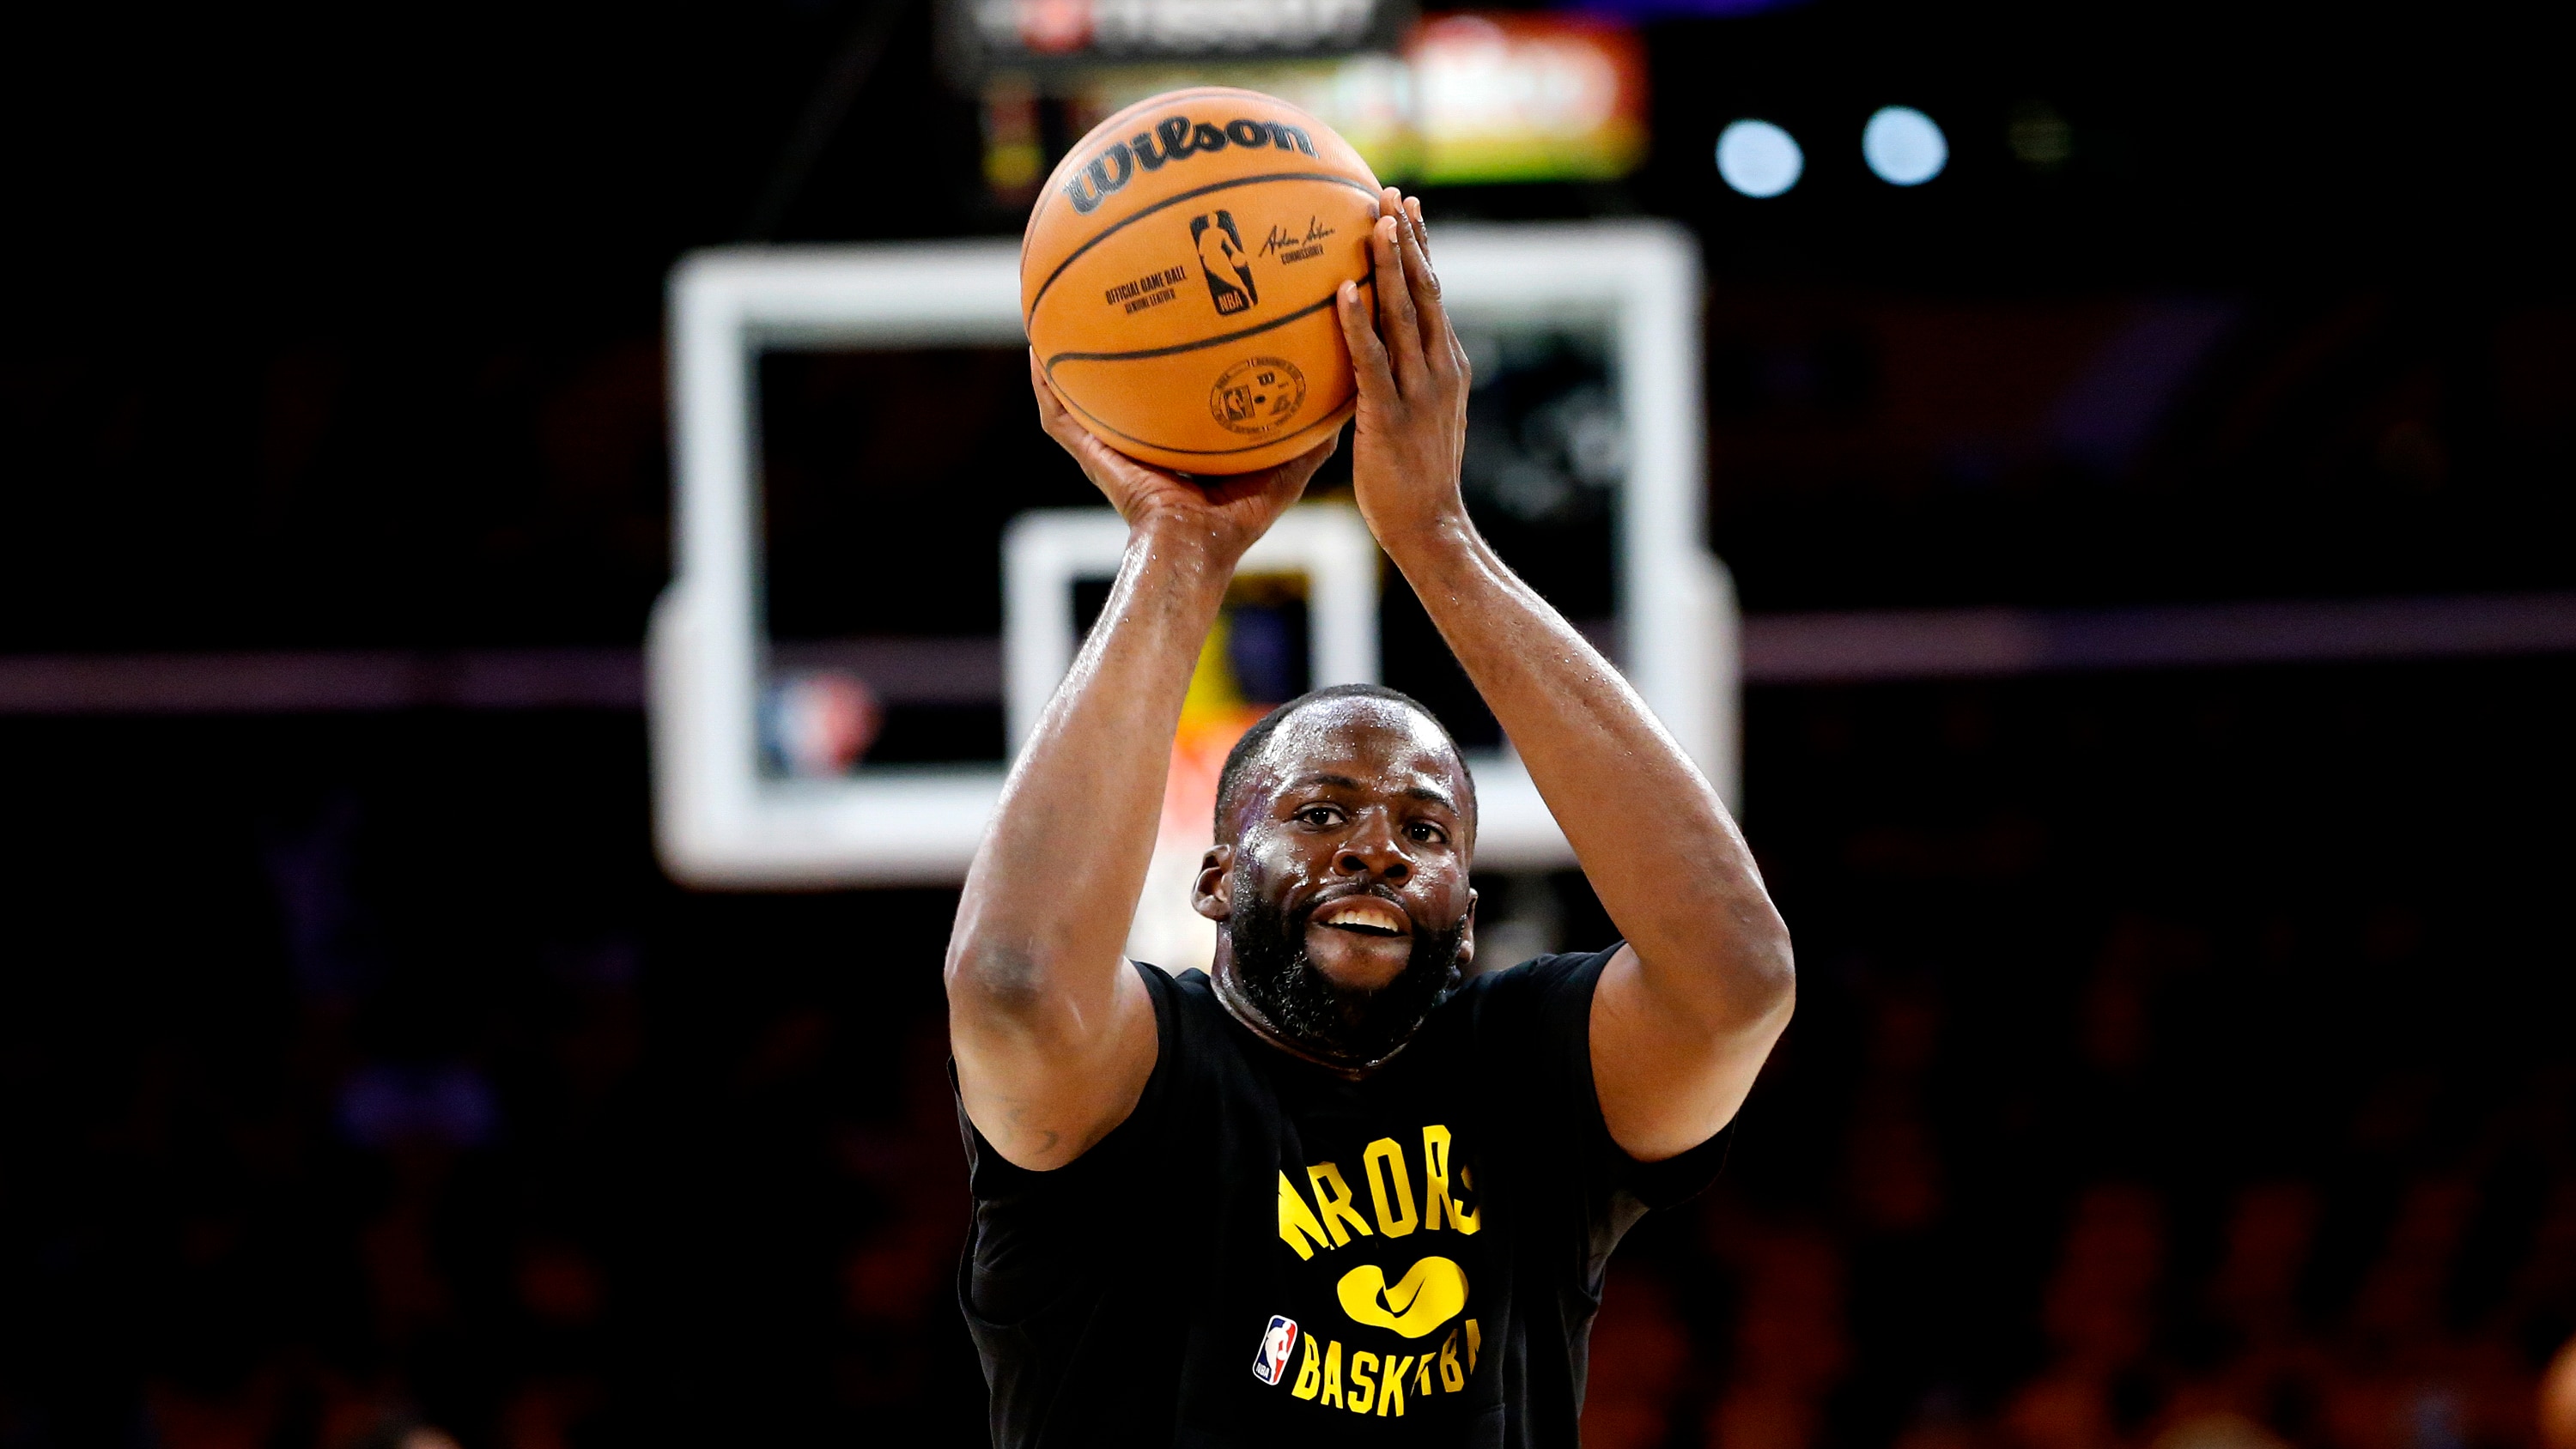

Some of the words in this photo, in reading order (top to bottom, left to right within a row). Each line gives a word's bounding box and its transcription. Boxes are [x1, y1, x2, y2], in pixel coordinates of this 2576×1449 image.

[1062, 115, 1319, 215] Wilson
[1280, 243, 1324, 266] COMMISSIONER
[1105, 280, 1140, 305] OFFICIAL
[1140, 270, 1164, 293] GAME
[1163, 264, 1187, 286] BALL
[1218, 290, 1243, 312] NBA
[1255, 1362, 1270, 1379] NBA
